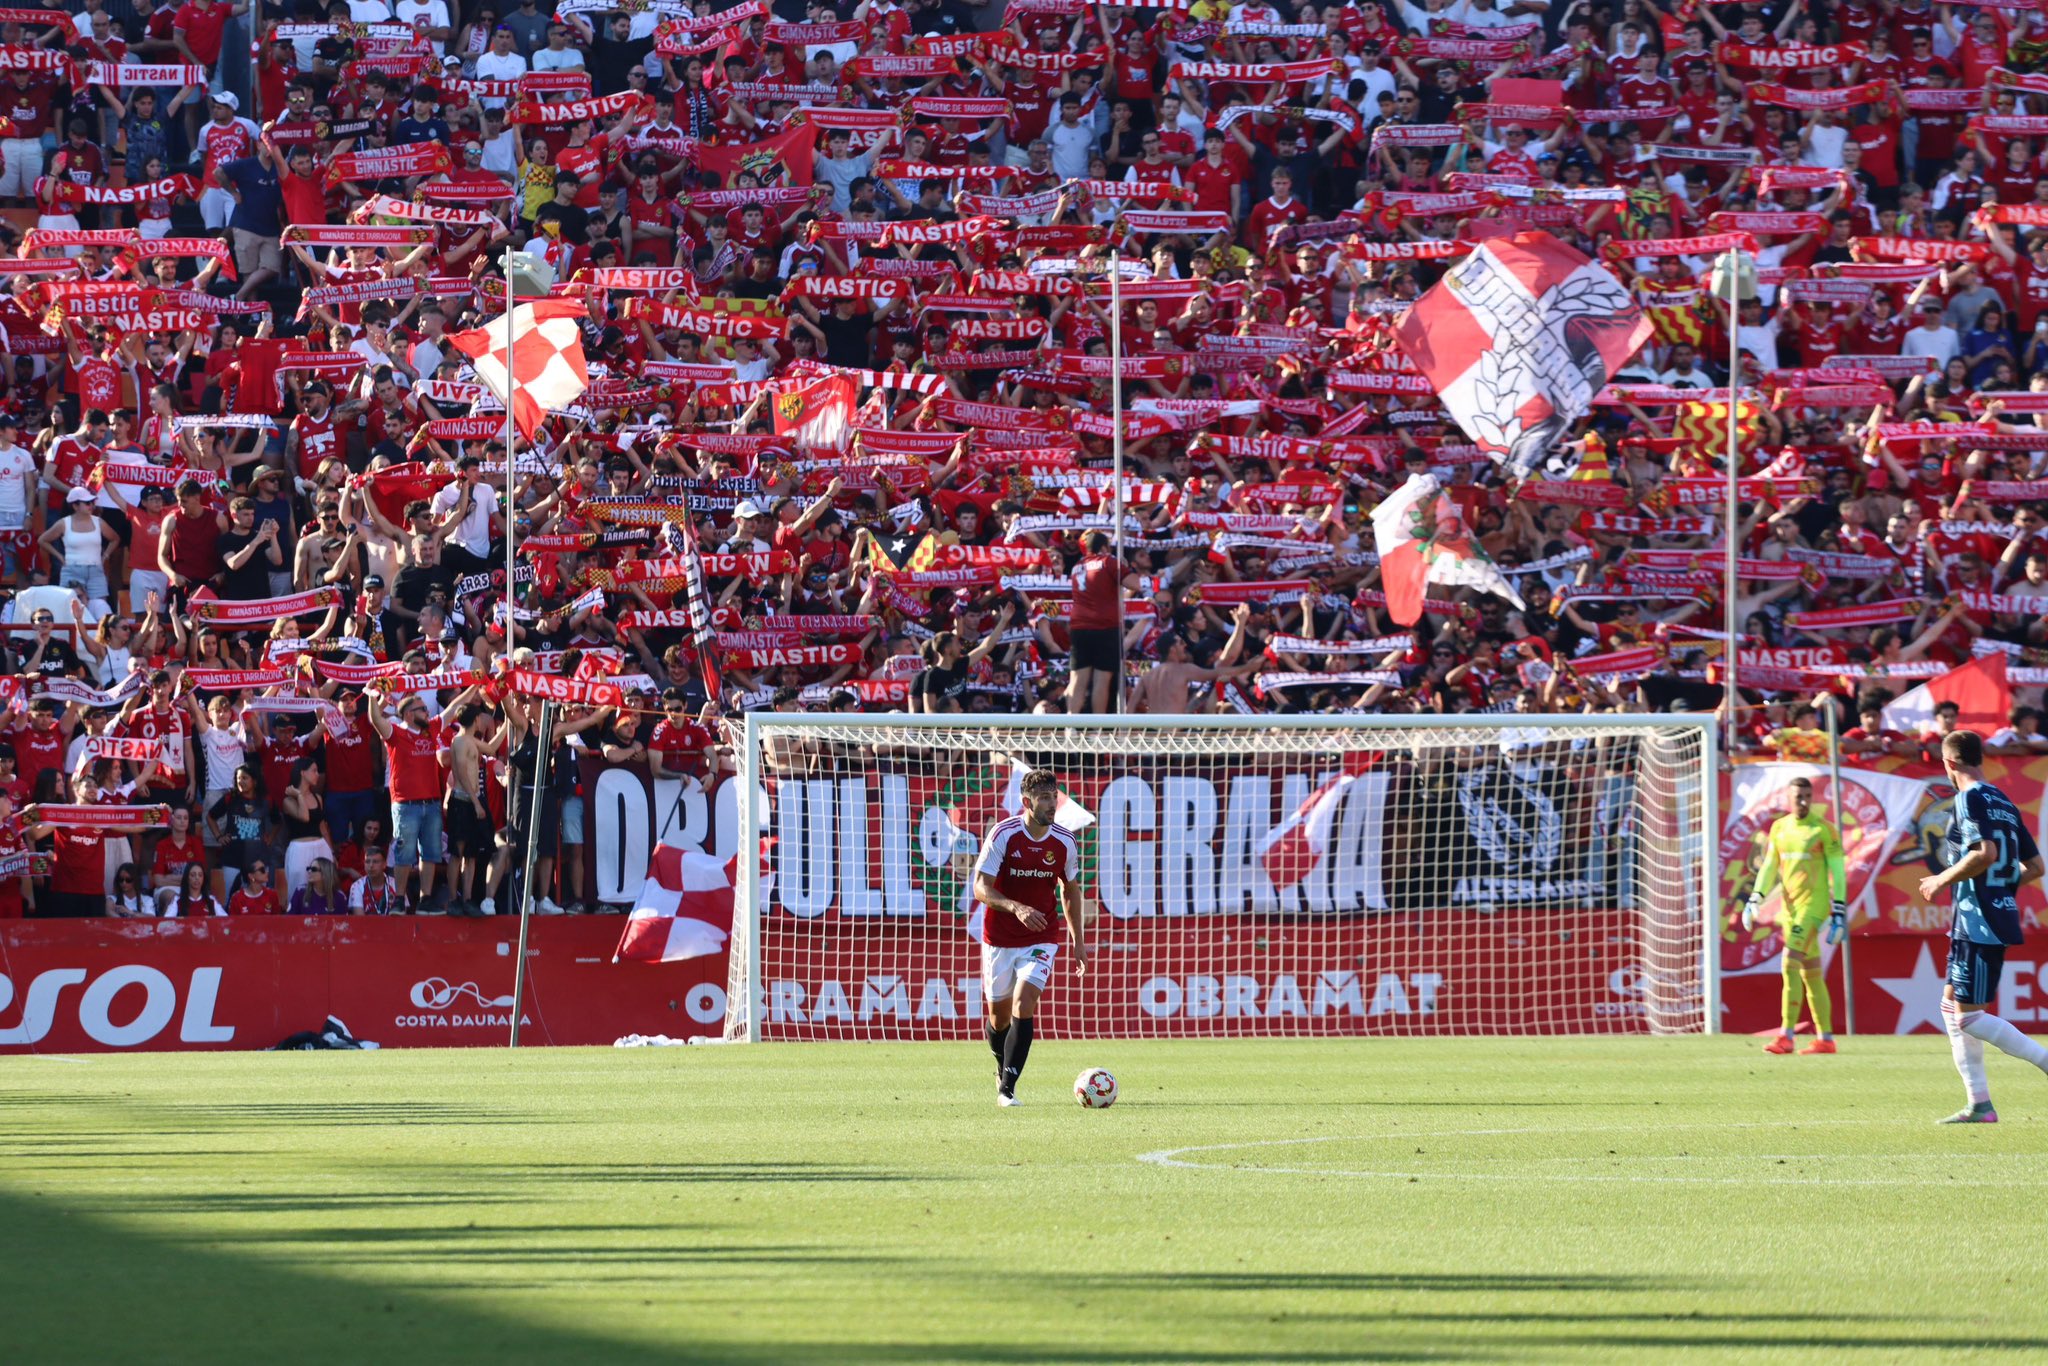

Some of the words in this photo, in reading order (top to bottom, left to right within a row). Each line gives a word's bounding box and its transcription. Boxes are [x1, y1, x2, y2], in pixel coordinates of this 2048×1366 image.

[672, 1, 760, 31] TORNAREM
[778, 26, 840, 39] GIMNASTIC
[991, 44, 1077, 69] NASTIC
[1428, 42, 1495, 55] GIMNASTIC
[872, 58, 935, 70] GIMNASTIC
[1750, 48, 1839, 68] NASTIC
[1182, 62, 1272, 78] NASTIC
[541, 96, 626, 122] NASTIC
[952, 103, 962, 112] DE
[333, 121, 369, 134] TARRAGONA
[355, 158, 418, 173] GIMNASTIC
[84, 179, 175, 203] NASTIC
[711, 190, 789, 204] GIMNASTIC
[32, 229, 133, 243] TORNAREM
[319, 230, 355, 241] GIMNÀSTIC
[356, 232, 364, 240] DE
[366, 232, 401, 241] TARRAGONA
[892, 218, 982, 242] NASTIC
[137, 240, 230, 260] TORNAREM
[1366, 242, 1456, 258] NASTIC
[1878, 238, 1973, 260] NASTIC
[874, 260, 938, 271] GIMNASTIC
[343, 285, 355, 294] DE
[358, 278, 414, 292] TARRAGONA
[593, 270, 684, 287] NASTIC
[805, 278, 897, 296] NASTIC
[980, 272, 1074, 294] NASTIC
[70, 294, 139, 312] nàstic
[179, 292, 249, 310] GIMNASTIC
[346, 293, 358, 302] de
[359, 288, 399, 301] primera
[116, 311, 201, 331] NASTIC
[662, 307, 752, 336] NASTIC
[958, 319, 1043, 338] NASTIC
[680, 366, 687, 376] DE
[689, 367, 723, 378] TARRAGONA
[1081, 359, 1146, 373] GIMNSTIC
[954, 404, 1020, 423] GIMNASTIC
[1916, 423, 1936, 433] AL
[698, 435, 761, 449] GIMNASTIC
[985, 430, 1050, 446] GIMNASTIC
[107, 463, 176, 482] GIMNASTIC
[609, 509, 666, 522] NASTIC
[604, 530, 650, 542] TARRAGONA
[227, 605, 263, 618] GIMNÀSTIC
[264, 604, 276, 614] DE
[276, 599, 307, 614] TARRAGONA
[800, 615, 865, 627] GIMNASTIC
[719, 632, 784, 648] GIMNASTIC
[752, 644, 847, 668] NASTIC
[1740, 648, 1834, 668] NASTIC
[232, 673, 242, 683] DE
[244, 670, 283, 682] TARRAGONA
[517, 672, 612, 703] NASTIC
[1100, 771, 1391, 919] GRANA
[1017, 868, 1054, 878] parlem
[1897, 905, 2040, 929] TARRA
[686, 975, 982, 1024] OBRAMAT
[1140, 970, 1443, 1018] OBRAMAT
[0, 964, 236, 1047] SOL
[396, 1014, 448, 1028] COSTA
